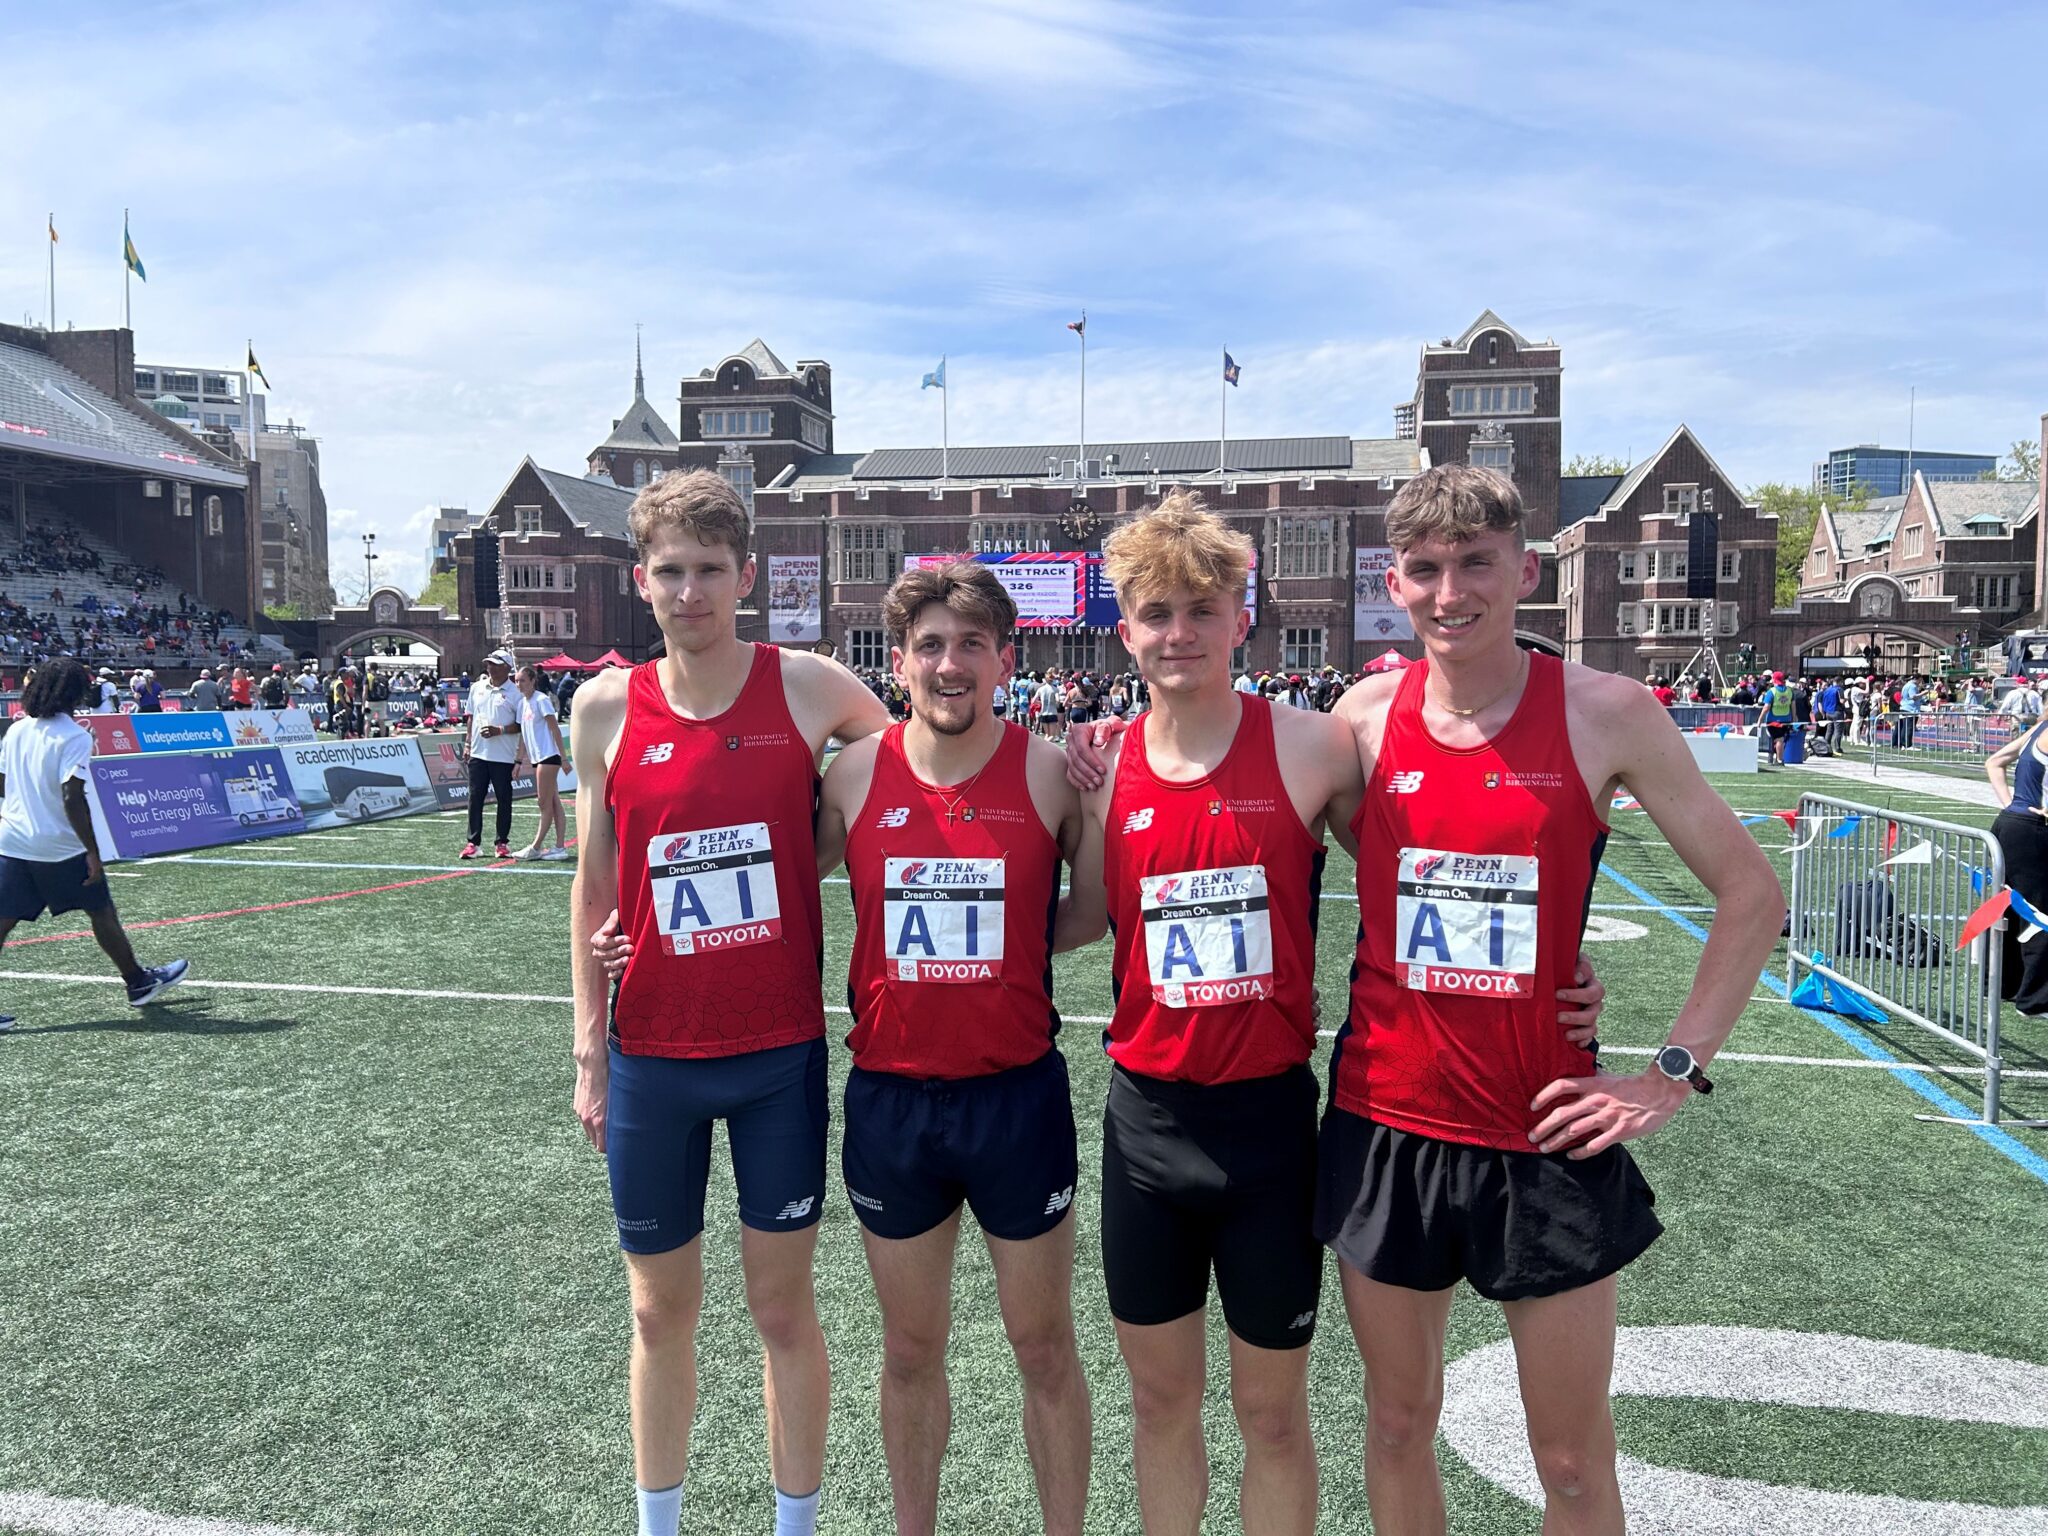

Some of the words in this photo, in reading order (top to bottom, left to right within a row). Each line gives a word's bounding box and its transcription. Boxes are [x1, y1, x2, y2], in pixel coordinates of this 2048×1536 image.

[973, 539, 1050, 553] FRANKLIN
[1374, 553, 1393, 561] PE
[784, 561, 818, 569] PENN
[1359, 561, 1395, 570] RELA
[771, 569, 819, 577] RELAYS
[997, 568, 1022, 576] THE
[1024, 568, 1067, 576] TRACK
[1028, 626, 1082, 636] JOHNSON
[1090, 626, 1117, 636] FAMI
[298, 703, 329, 714] TOYOT
[388, 702, 419, 712] TOYOTA
[142, 729, 212, 745] Independence
[274, 733, 314, 743] compression
[744, 739, 789, 747] BIRMINGHAM
[295, 743, 409, 766] academybus.com
[109, 769, 129, 779] peco
[1505, 772, 1554, 780] UNIVERSITY
[1505, 779, 1562, 787] BIRMINGHAM
[116, 790, 147, 807] Help
[147, 785, 205, 803] Managing
[121, 810, 150, 825] Your
[150, 807, 191, 821] Energy
[193, 802, 220, 816] Bills.
[1226, 805, 1275, 813] BIRMINGHAM
[979, 814, 1025, 824] BIRMINGHAM
[130, 824, 179, 839] peco.com/help
[698, 829, 740, 845] PENN
[697, 838, 754, 856] RELAYS
[668, 865, 700, 876] Dream
[701, 861, 719, 870] On.
[934, 862, 976, 873] PENN
[1453, 857, 1503, 870] PENN
[931, 873, 989, 884] RELAYS
[1190, 871, 1234, 887] PENN
[1450, 869, 1518, 884] RELAYS
[902, 890, 932, 900] Dream
[933, 890, 950, 900] On.
[1189, 882, 1249, 899] RELAYS
[1415, 886, 1450, 898] Dream
[1451, 888, 1472, 899] On.
[669, 878, 712, 930] A
[1161, 909, 1193, 919] Dream
[1193, 906, 1212, 916] On.
[696, 924, 771, 948] TOYOTA
[895, 905, 937, 956] A
[1406, 902, 1452, 962] A
[1161, 923, 1204, 979] A
[920, 963, 992, 979] TOYOTA
[1430, 971, 1520, 992] TOYOTA
[1188, 979, 1263, 1002] TOYOTA
